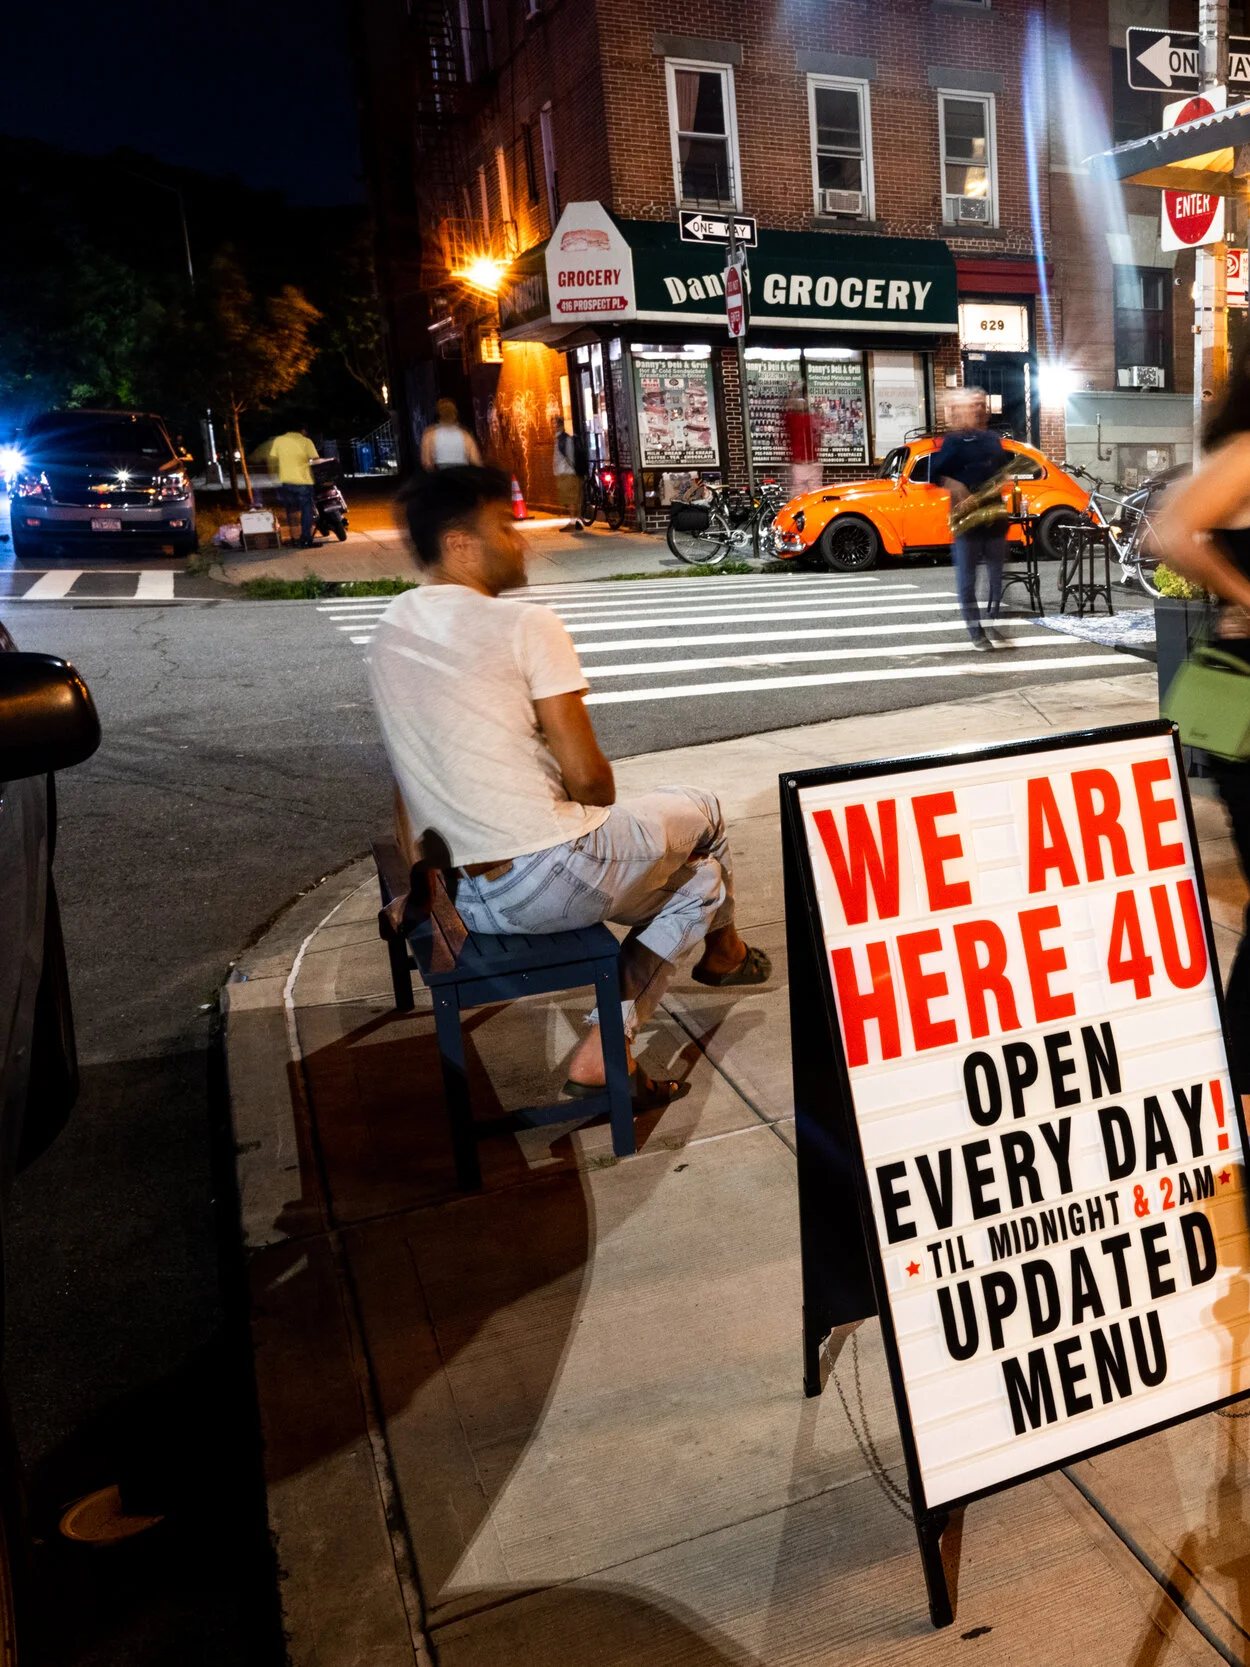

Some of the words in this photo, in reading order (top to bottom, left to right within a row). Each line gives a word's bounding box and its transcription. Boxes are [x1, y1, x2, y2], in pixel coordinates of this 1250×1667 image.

[1169, 50, 1200, 74] ON
[1175, 193, 1211, 219] ENTER
[693, 221, 714, 234] ONE
[558, 269, 622, 287] GROCERY
[762, 273, 933, 311] GROCERY
[561, 300, 573, 312] 416
[573, 298, 611, 311] PROSPECT
[611, 297, 624, 310] PL.
[980, 320, 1005, 331] 629
[635, 360, 666, 370] Danny's
[667, 360, 683, 369] Deli
[683, 361, 690, 369] &
[691, 360, 708, 369] Grill
[808, 364, 831, 375] Danny's
[812, 790, 973, 927] WE
[1026, 757, 1186, 894] ARE
[830, 904, 1077, 1069] HERE
[1106, 878, 1209, 1000] 4U
[962, 1021, 1123, 1127] OPEN
[875, 1116, 1075, 1245] EVERY
[1098, 1079, 1230, 1183] DAY!
[927, 1235, 974, 1279] TIL
[986, 1191, 1121, 1262] MIDNIGHT
[1133, 1184, 1151, 1218] &
[1159, 1165, 1216, 1212] 2AM
[936, 1210, 1219, 1362] UPDATED
[1000, 1309, 1169, 1436] MENU
